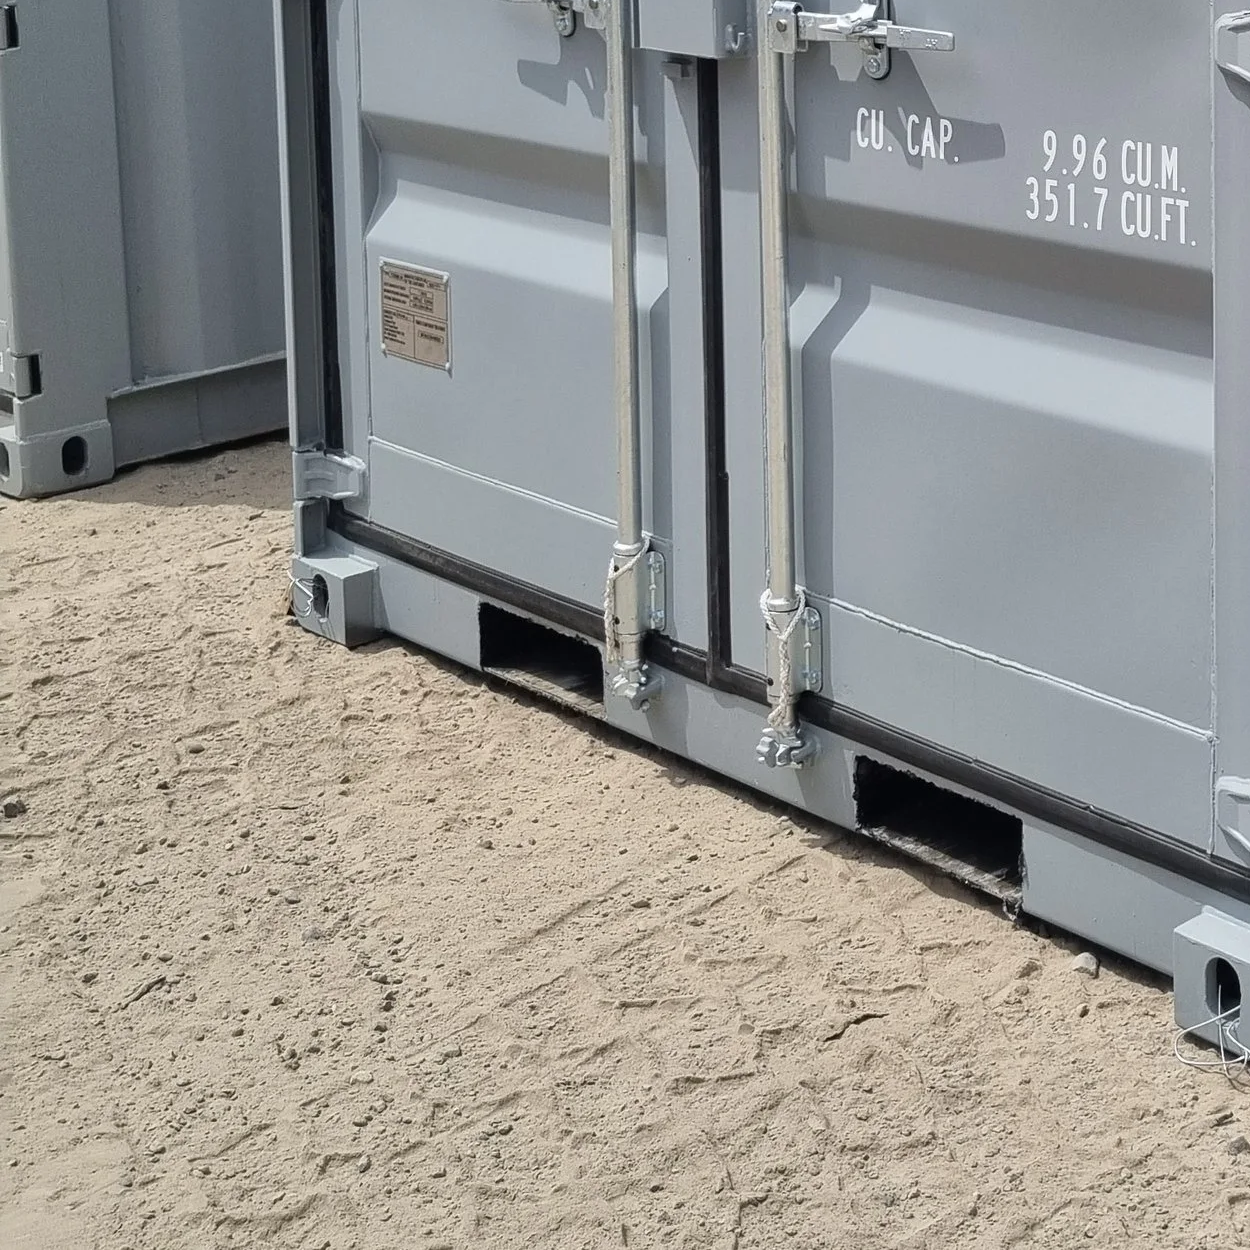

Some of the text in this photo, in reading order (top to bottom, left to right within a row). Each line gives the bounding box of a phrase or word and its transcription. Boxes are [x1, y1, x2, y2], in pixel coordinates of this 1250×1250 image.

[855, 106, 1187, 193] CU. CAP. 9.96 CU.M.
[1024, 176, 1198, 247] 351.7 CU.FT.
